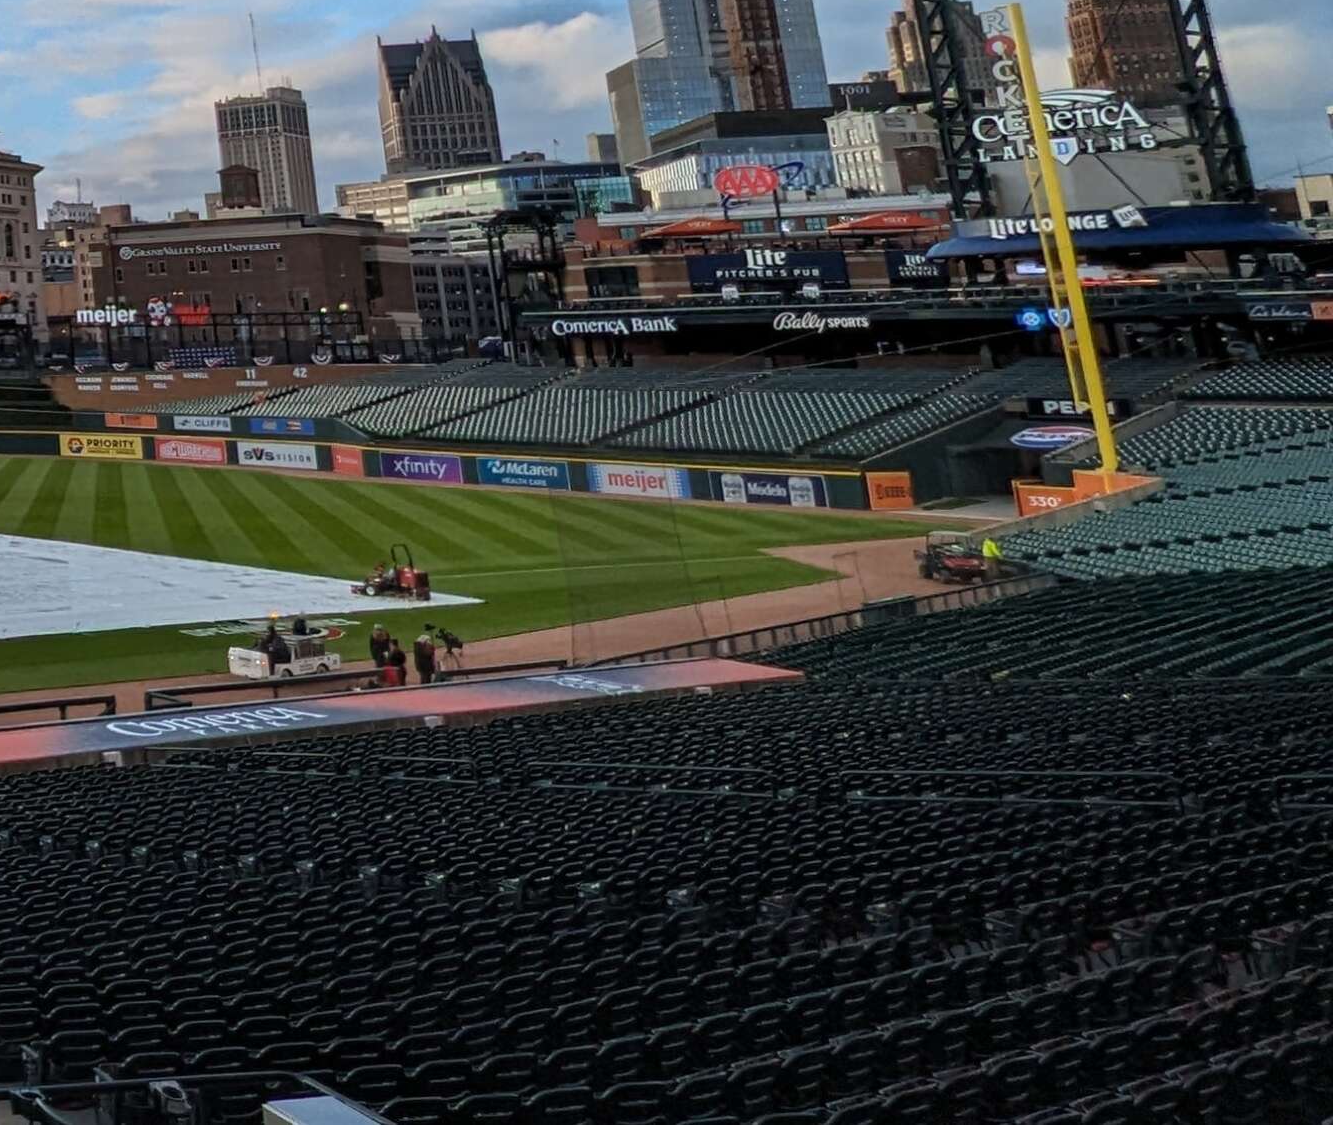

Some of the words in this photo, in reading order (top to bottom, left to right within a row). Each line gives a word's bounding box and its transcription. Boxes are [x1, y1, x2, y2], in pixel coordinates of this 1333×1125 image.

[722, 168, 768, 195] AAA
[988, 218, 1028, 240] Lite
[1030, 214, 1109, 233] LONGE
[132, 247, 163, 258] GRAND
[163, 246, 195, 256] VALLEY
[195, 244, 223, 255] STATE
[224, 241, 282, 252] UNIVERSITY
[744, 248, 787, 269] Lite
[716, 269, 787, 278] PITCHER'S
[793, 268, 820, 277] PUB
[76, 305, 137, 327] meijer
[631, 316, 678, 333] Bank
[773, 311, 826, 334] Bally
[827, 316, 870, 328] SPORTS
[245, 368, 256, 379] 11
[292, 367, 308, 378] 42
[1043, 400, 1114, 416] PEPI
[194, 418, 230, 429] CLIFFS
[86, 438, 135, 449] PRIORITY
[244, 447, 275, 462] SVS
[276, 452, 312, 464] VISION
[393, 456, 447, 479] xfinity
[505, 462, 558, 478] McLaren
[501, 477, 527, 486] HEALTH
[529, 478, 548, 487] CARE
[607, 470, 668, 492] meijer
[747, 481, 787, 498] Modelo
